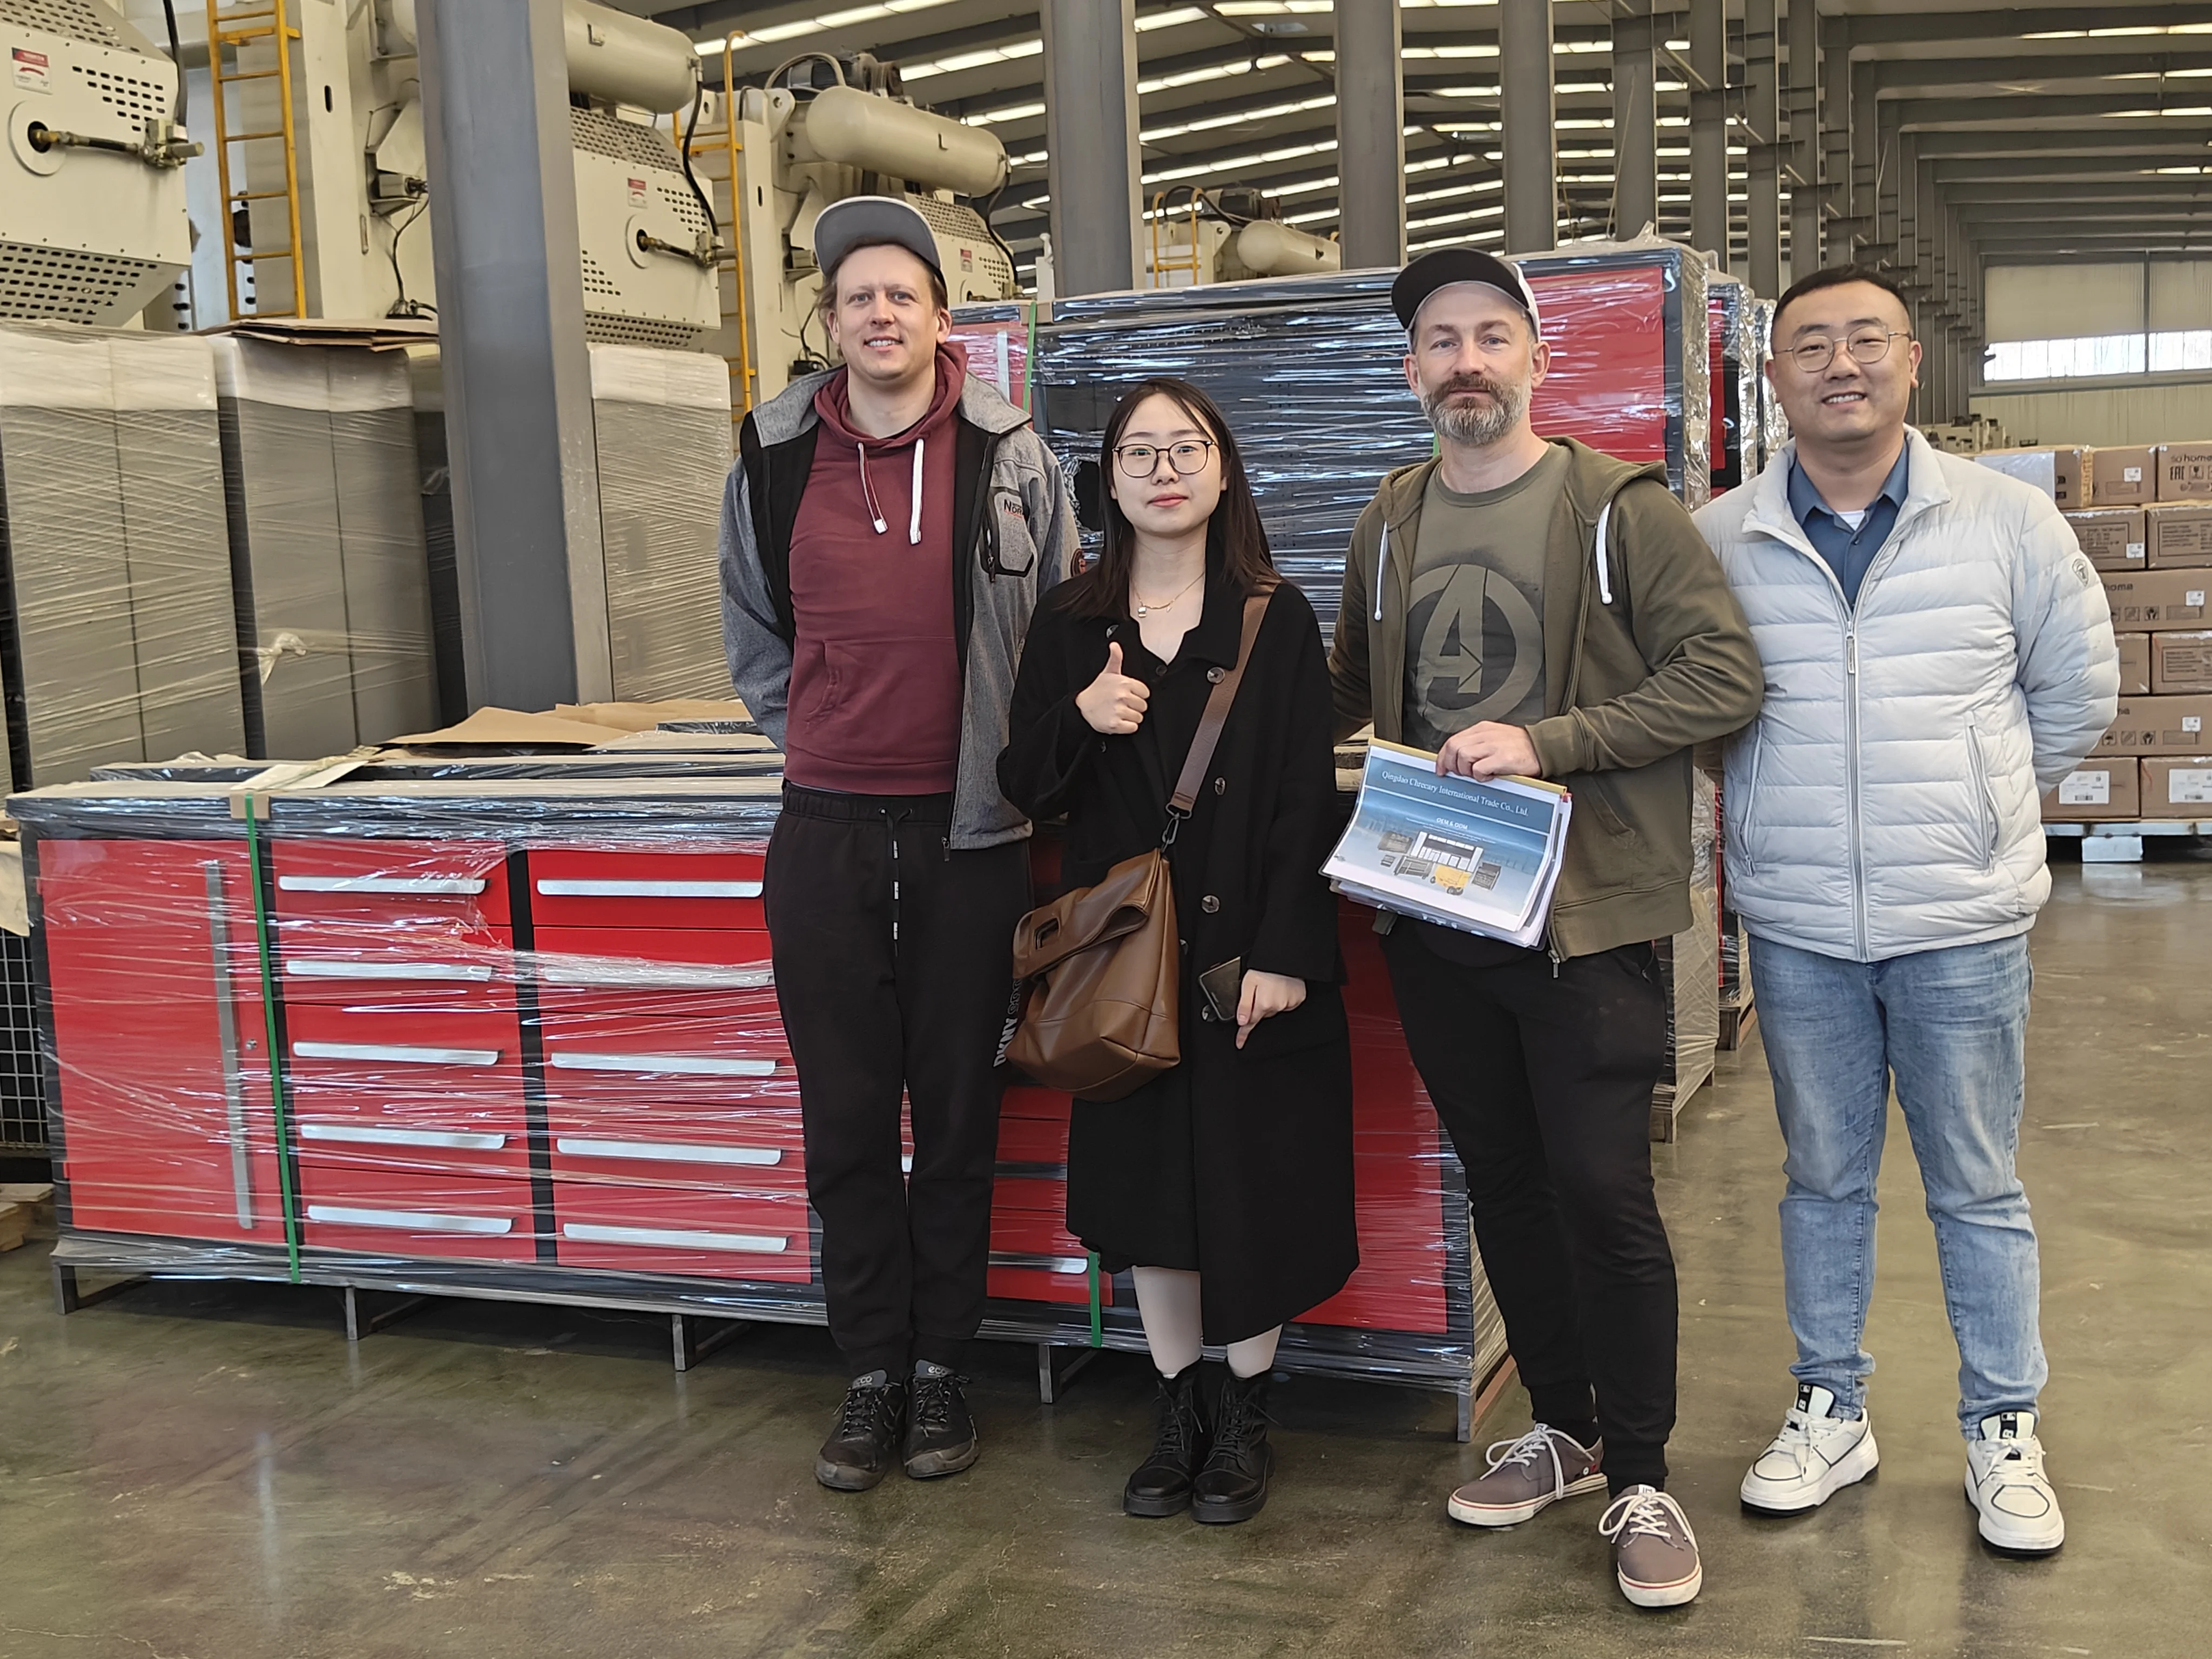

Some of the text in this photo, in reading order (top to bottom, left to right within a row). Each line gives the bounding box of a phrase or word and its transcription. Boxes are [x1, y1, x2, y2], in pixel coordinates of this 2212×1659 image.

[1381, 770, 1408, 784] Qingdao
[1439, 785, 1480, 804] International
[1481, 796, 1499, 808] Trade
[1515, 805, 1529, 817] Ltd.
